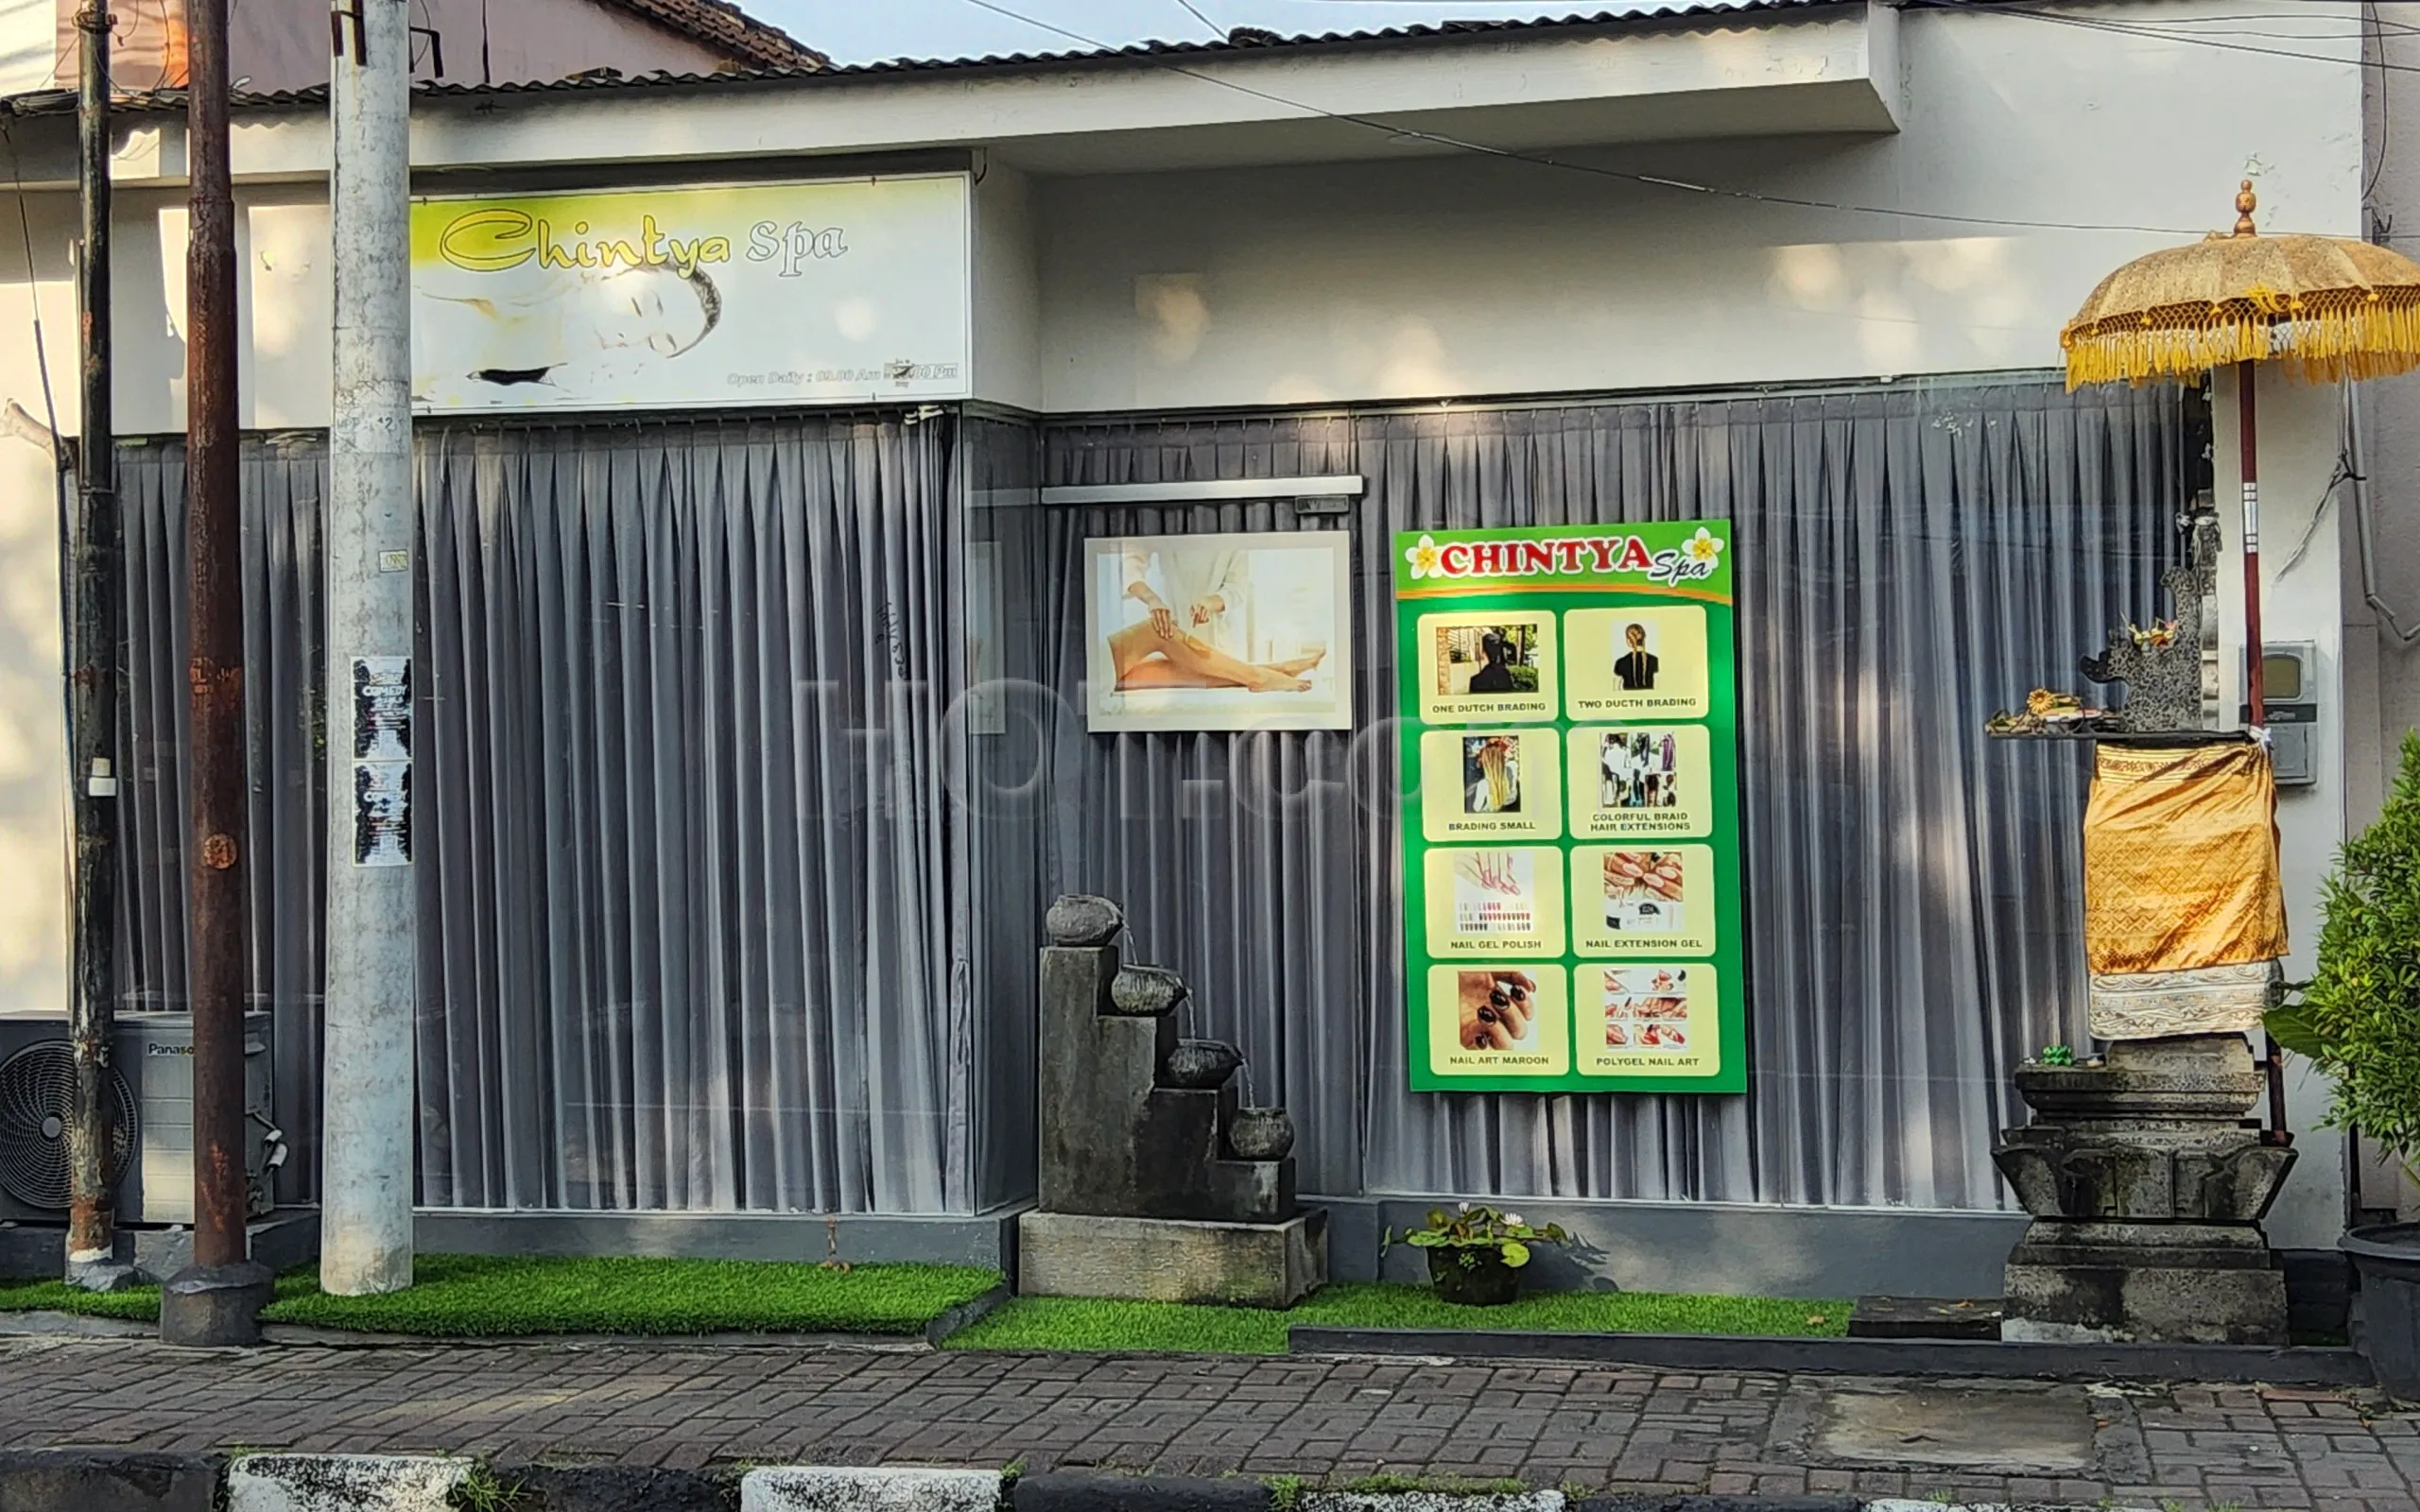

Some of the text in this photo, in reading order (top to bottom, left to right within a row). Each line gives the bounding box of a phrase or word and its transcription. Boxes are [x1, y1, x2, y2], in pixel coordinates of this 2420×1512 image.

[440, 208, 848, 279] Chintya Spa
[727, 371, 764, 387] Open
[768, 369, 804, 386] Daily
[1440, 539, 1709, 583] CHINTYA Spa
[1432, 702, 1547, 713] ONE DUTCH BRADING
[1578, 697, 1696, 709] TWO DUCTH BRADING
[1592, 812, 1687, 821] COLORFUL BRAID
[1448, 821, 1536, 831] BRADING SMALL
[1590, 822, 1691, 832] HAIR EXTENSIONS
[1450, 940, 1542, 949] NAIL GEL POLISH
[1585, 939, 1703, 948] NAIL EXTENSION GEL
[148, 1042, 195, 1055] Panaso
[1449, 1057, 1549, 1065] NAIL ART MAROON
[1596, 1057, 1700, 1066] POLYGEL NAIL ART
